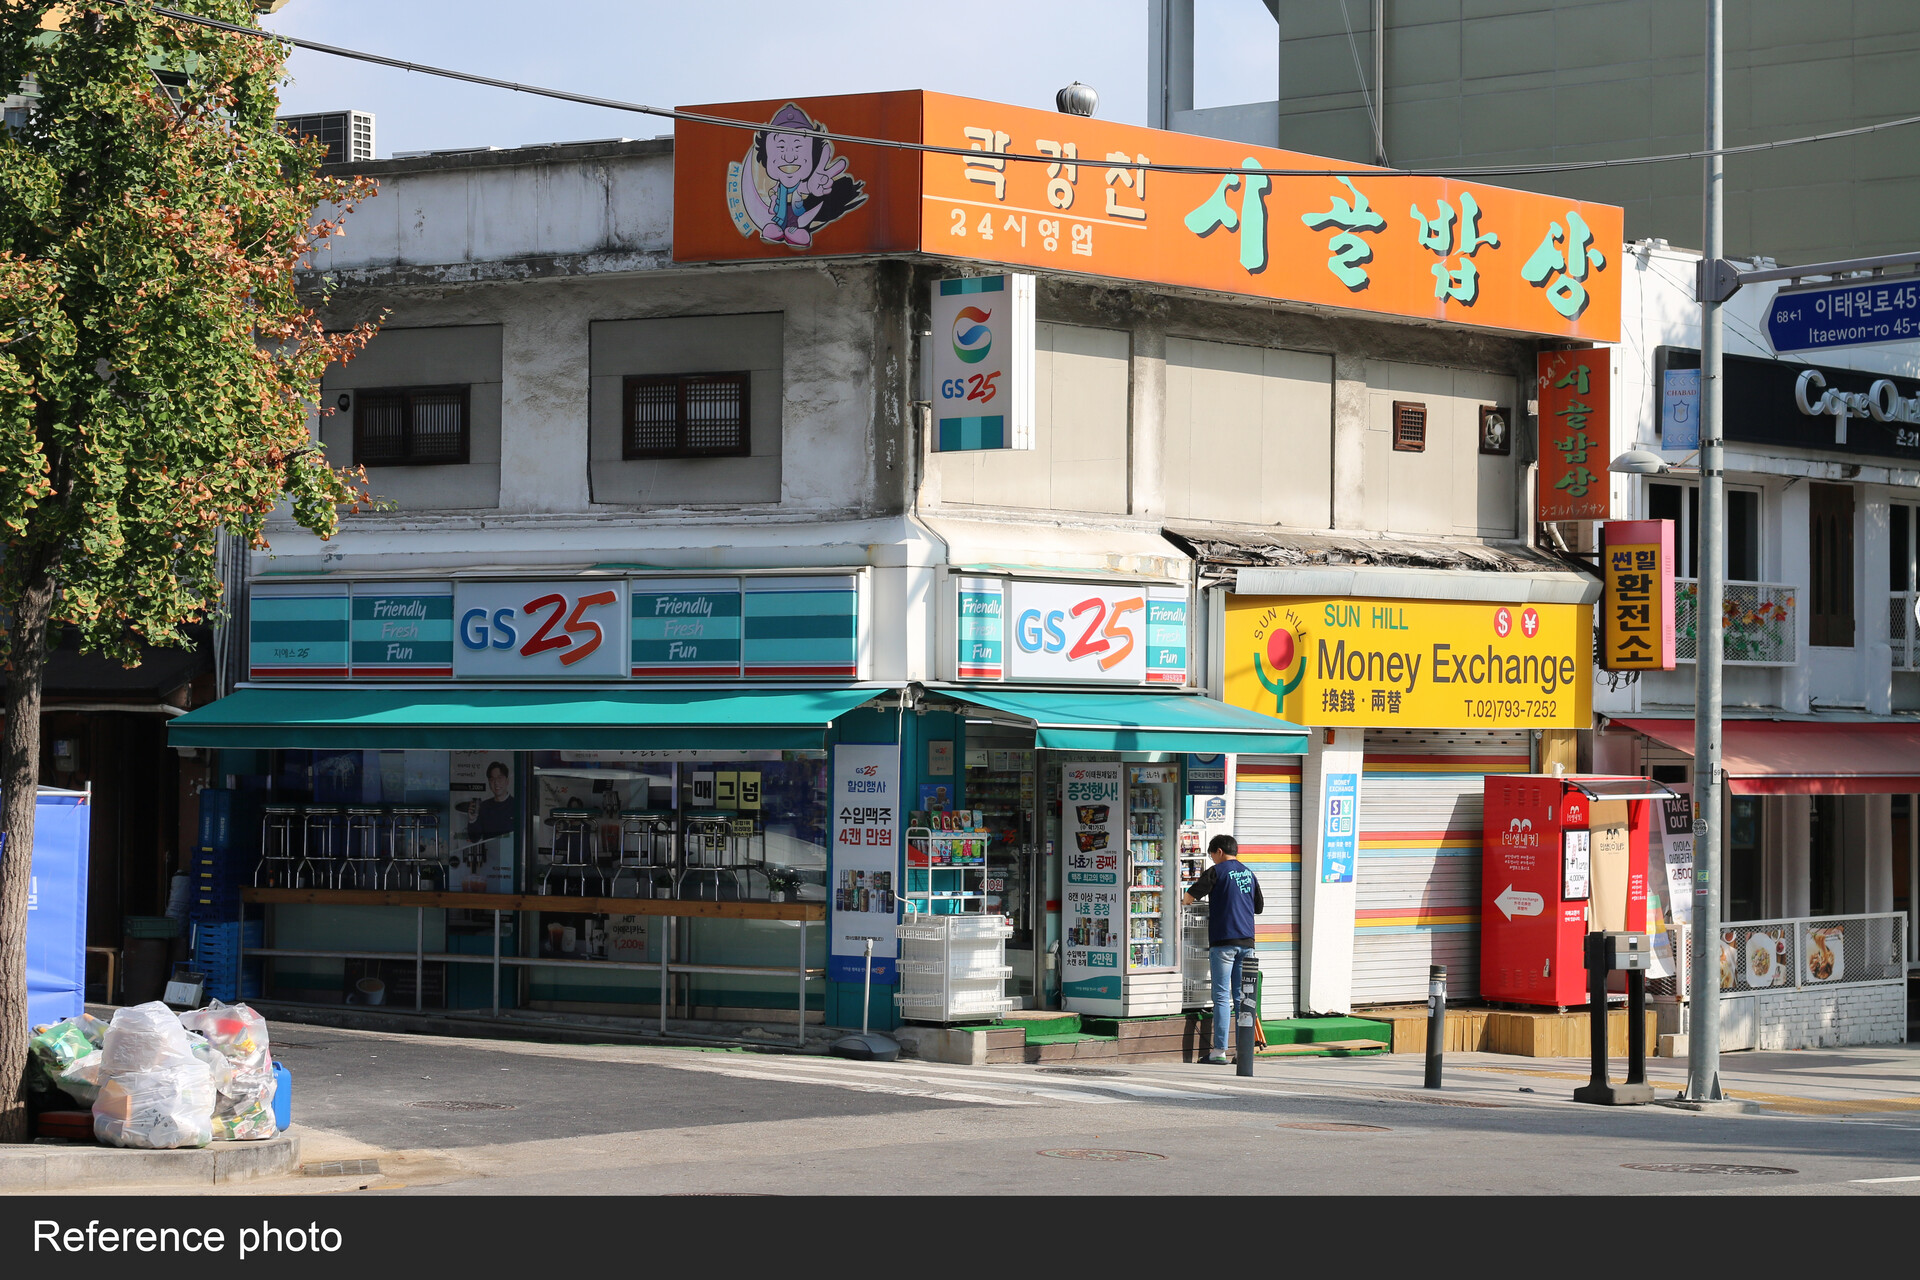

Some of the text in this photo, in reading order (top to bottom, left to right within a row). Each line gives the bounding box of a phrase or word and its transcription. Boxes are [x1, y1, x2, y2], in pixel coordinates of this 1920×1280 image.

[1184, 157, 1605, 321] 시골밥상
[1815, 286, 1920, 320] 이태원로45
[1809, 317, 1920, 343] Itaewon-ro 45-
[941, 370, 1002, 404] GS25
[1666, 389, 1697, 397] CHABAD
[1554, 364, 1599, 498] 시골밥상
[1611, 550, 1656, 571] 썬힐
[373, 600, 427, 618] Friendly
[655, 597, 713, 618] Friendly
[962, 597, 1002, 619] Friendly
[1150, 606, 1187, 626] Friendly
[1253, 606, 1307, 643] SUN HILL
[1324, 604, 1409, 630] SUN HILL
[1615, 574, 1654, 663] 환전소
[381, 622, 418, 639] Fresh
[459, 590, 618, 667] GS25
[664, 619, 704, 637] Fresh
[968, 621, 997, 636] Fresh
[1016, 596, 1145, 672] GS25
[1155, 627, 1182, 642] Fresh
[386, 643, 413, 660] Fun
[668, 641, 698, 660] Fun
[972, 643, 992, 659] Fun
[1159, 649, 1178, 665] Fun
[1317, 638, 1575, 694] Money Exchange
[855, 765, 879, 777] GS25
[847, 780, 887, 793] 할인행사
[1067, 782, 1119, 801] 증정행사!
[1208, 808, 1223, 819] 235
[1664, 799, 1689, 812] TAKE
[839, 807, 892, 825] 수입맥주
[1669, 815, 1688, 829] OUT
[839, 828, 892, 846] 4캔 만원
[1672, 840, 1691, 852] 아이스
[1068, 855, 1117, 870] 나쵸가 공짜!
[1668, 853, 1692, 864] 아메리카
[1068, 892, 1117, 903] 8캔 이상 구매 시
[1074, 903, 1110, 916] 나쵸 증정
[1091, 953, 1113, 966] 2만원
